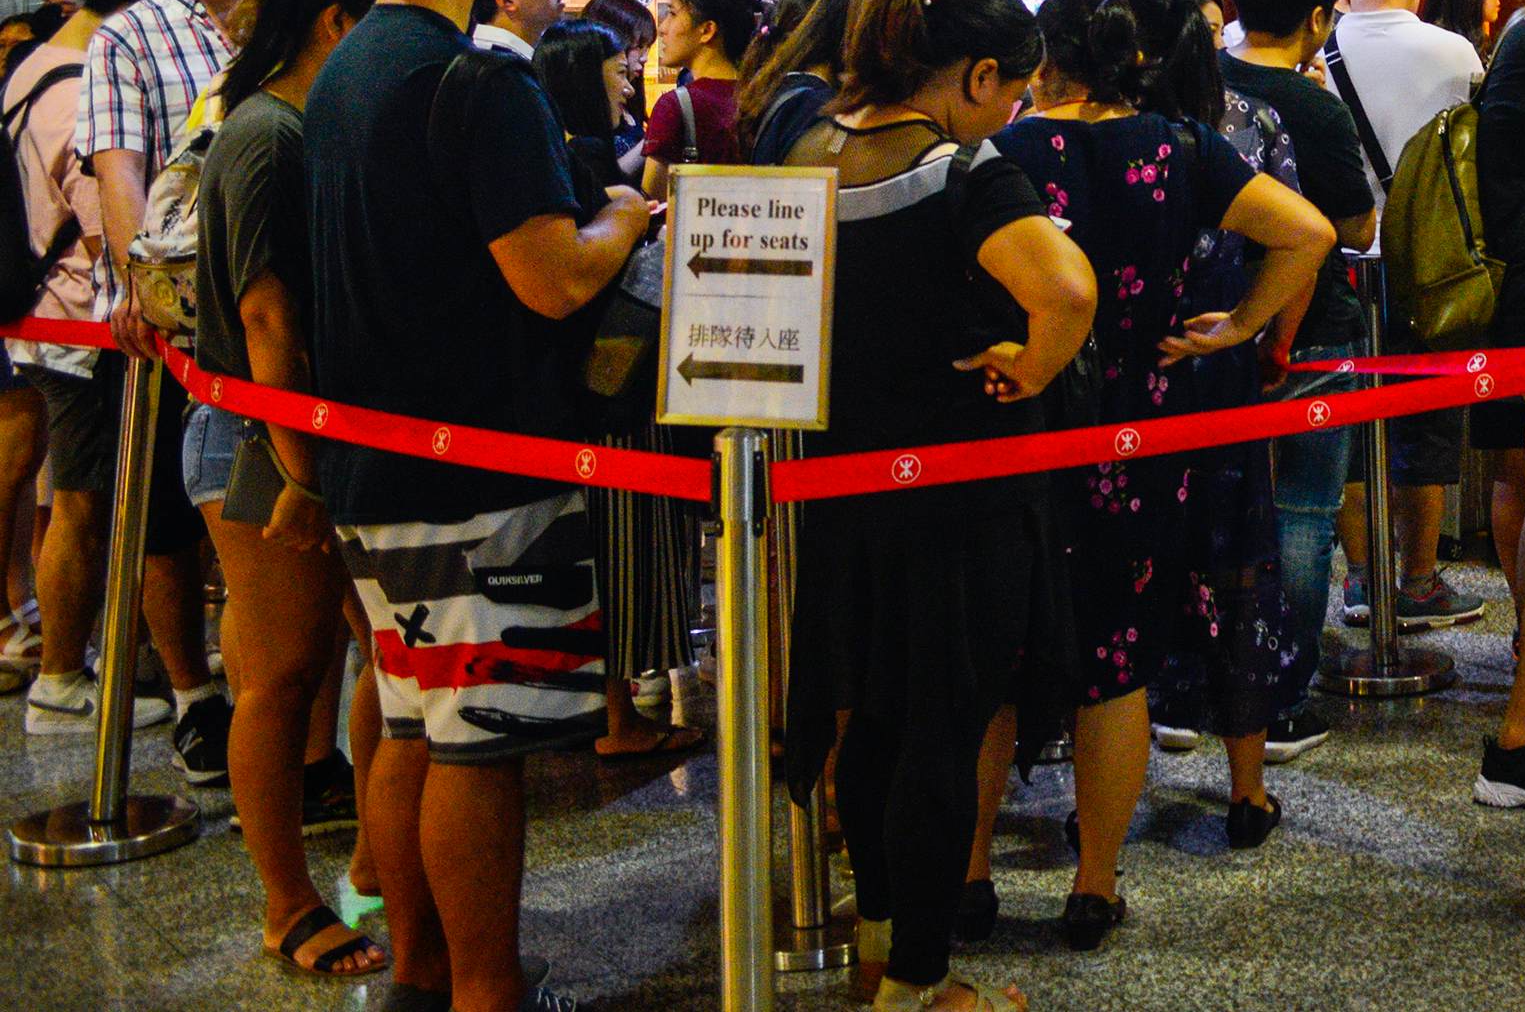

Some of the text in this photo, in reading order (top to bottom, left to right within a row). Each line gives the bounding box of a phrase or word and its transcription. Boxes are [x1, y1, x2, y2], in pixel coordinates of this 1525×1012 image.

[697, 197, 805, 219] Please line
[690, 229, 809, 253] up for seats
[687, 323, 801, 352] 排隊待入座
[488, 574, 543, 586] QUIKSILVER
